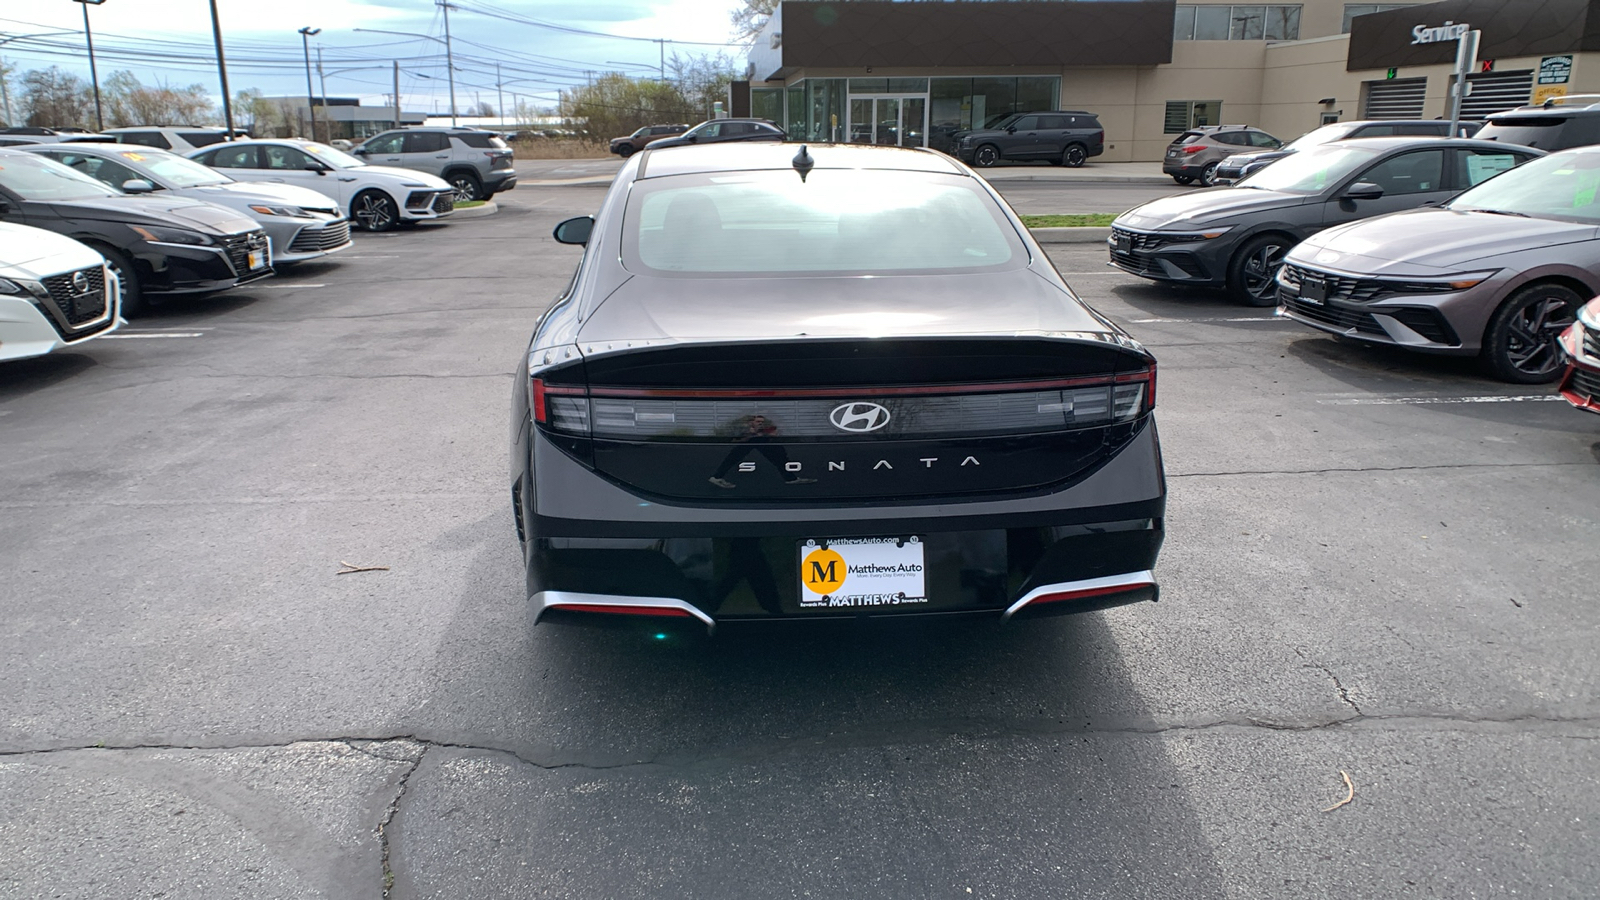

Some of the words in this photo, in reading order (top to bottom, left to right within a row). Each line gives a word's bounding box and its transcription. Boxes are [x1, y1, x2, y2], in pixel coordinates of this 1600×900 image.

[1411, 20, 1470, 45] Service
[738, 455, 981, 472] SONATA
[826, 537, 900, 546] MatthewsAuto.com
[809, 560, 839, 583] M
[848, 563, 896, 574] Matthews
[897, 563, 922, 572] Auto
[829, 594, 900, 607] MATTHEWS
